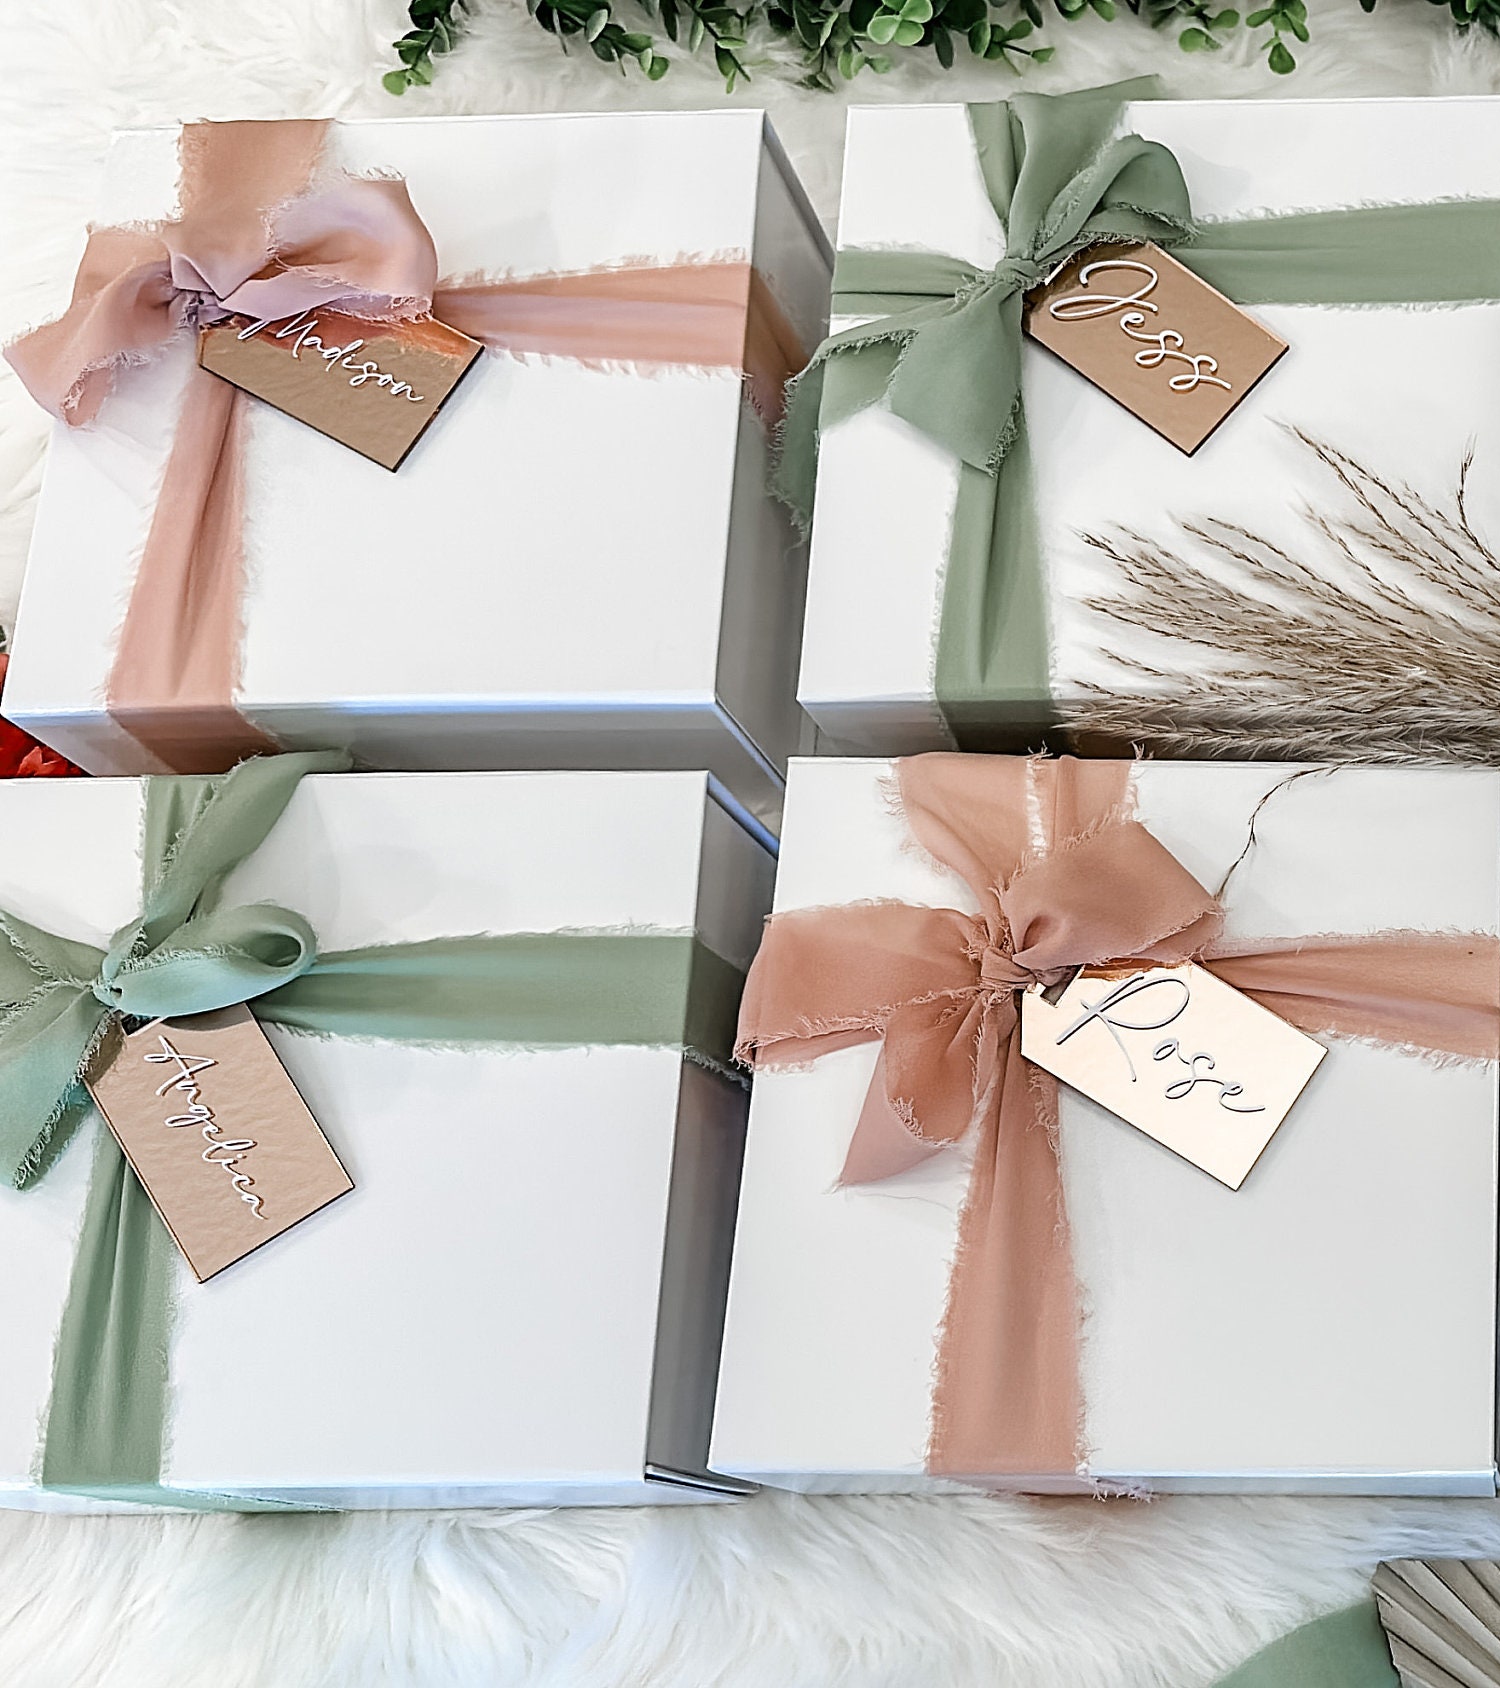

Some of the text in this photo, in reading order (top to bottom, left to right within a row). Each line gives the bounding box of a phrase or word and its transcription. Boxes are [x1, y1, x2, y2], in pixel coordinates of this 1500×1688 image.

[1049, 259, 1232, 391] Jess
[1056, 976, 1266, 1112] Rose
[144, 1035, 268, 1220] Angelica
